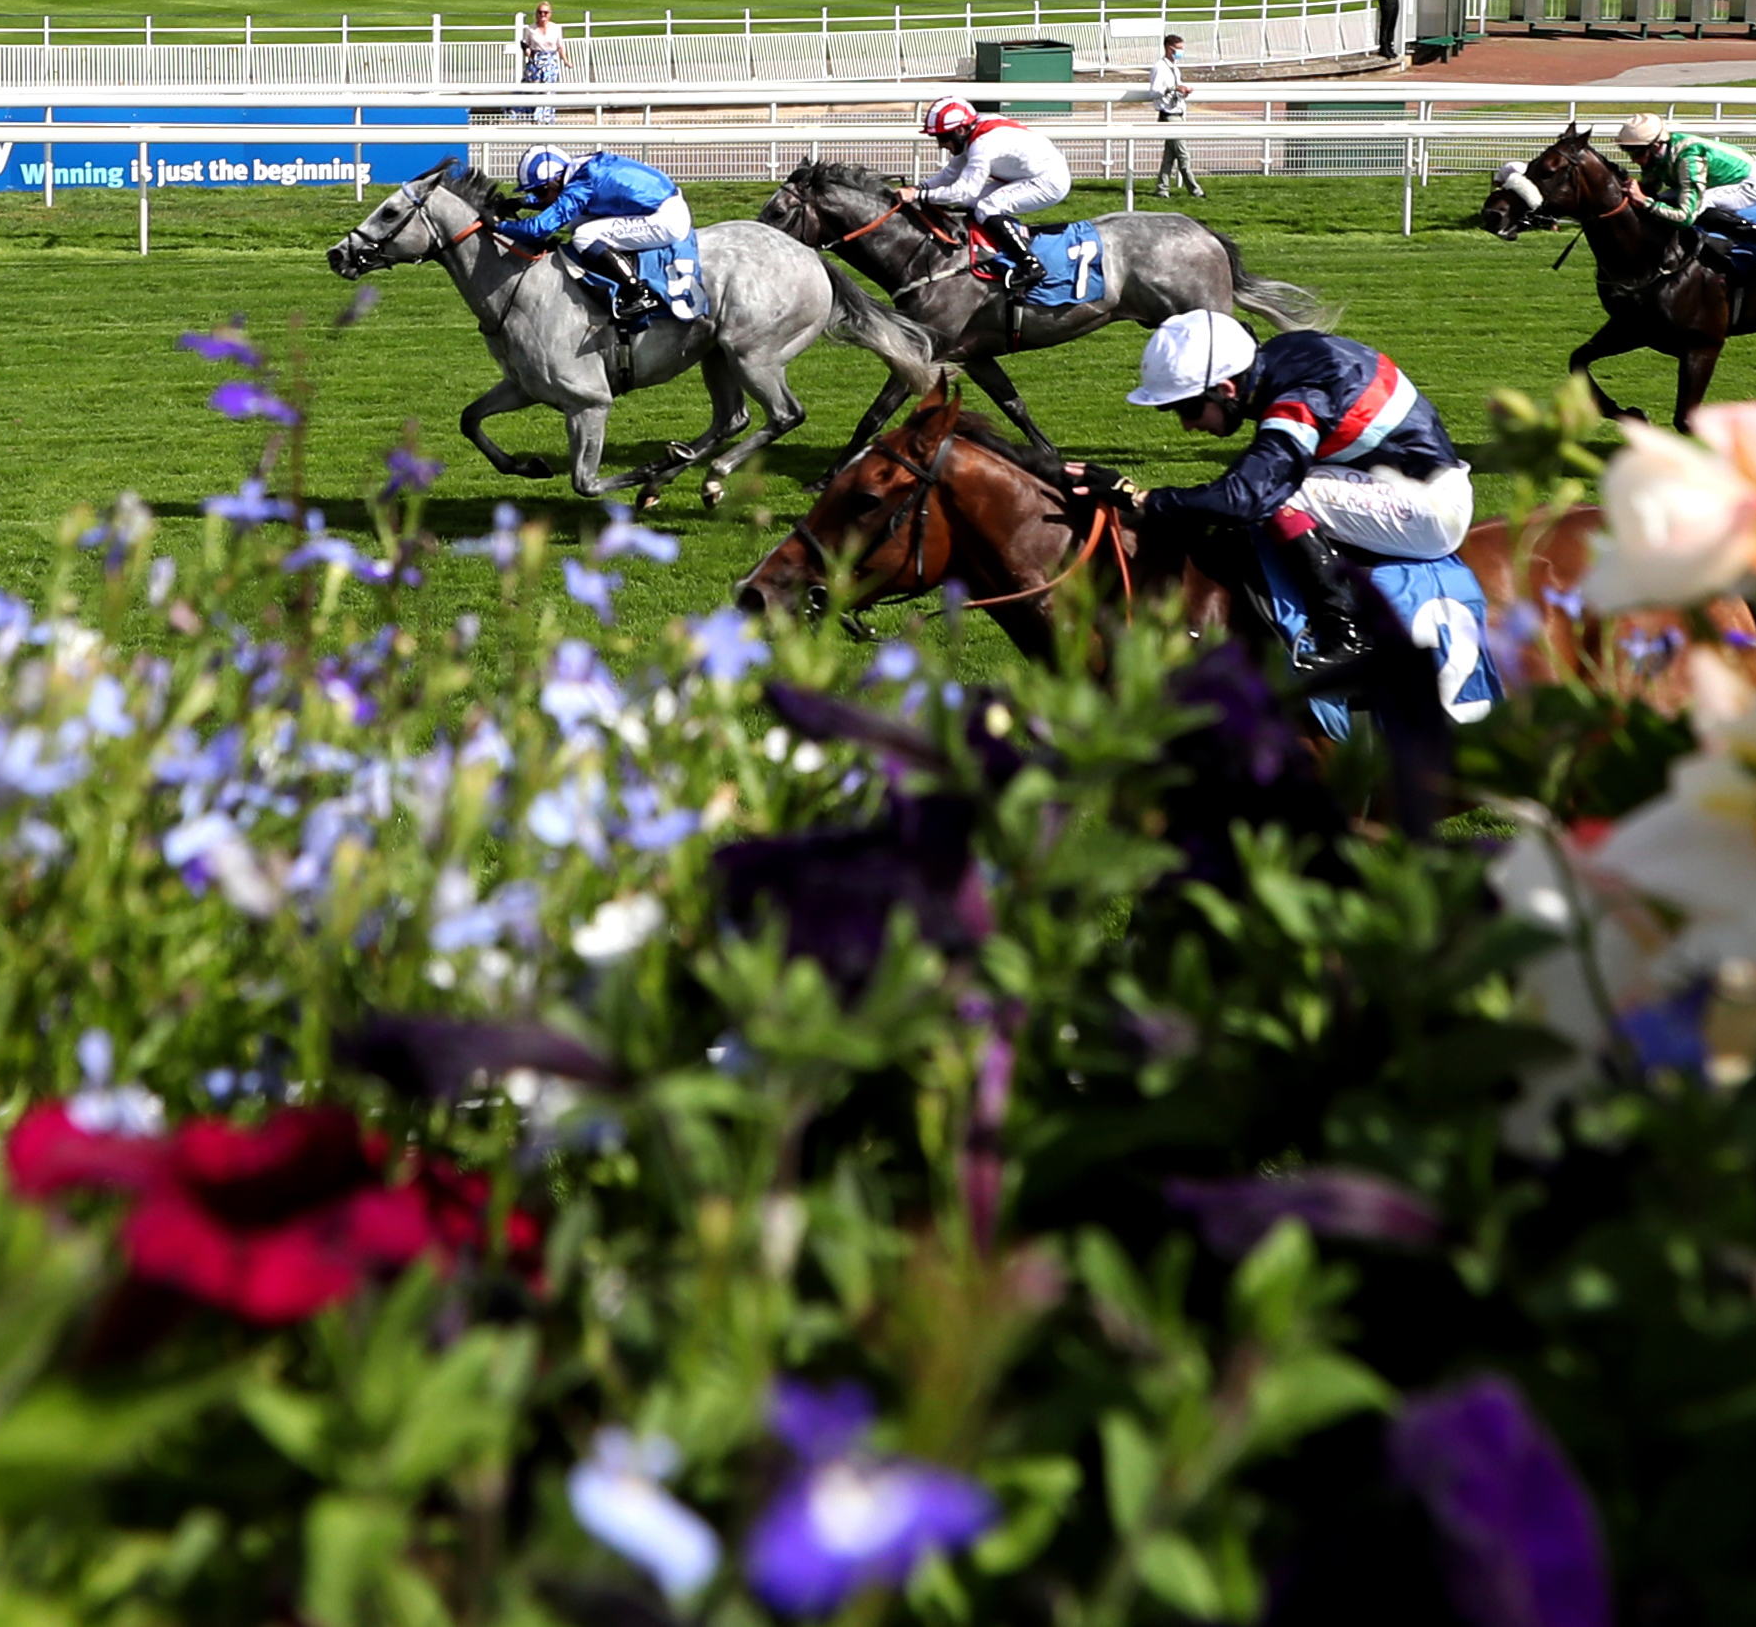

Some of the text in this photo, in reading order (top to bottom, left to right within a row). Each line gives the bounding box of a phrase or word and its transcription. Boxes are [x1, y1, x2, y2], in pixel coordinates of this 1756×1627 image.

[157, 159, 204, 188] just
[208, 159, 249, 182] the
[252, 157, 371, 186] beginning
[664, 258, 707, 320] 5
[1067, 240, 1098, 300] 7
[1411, 596, 1492, 724] 2
